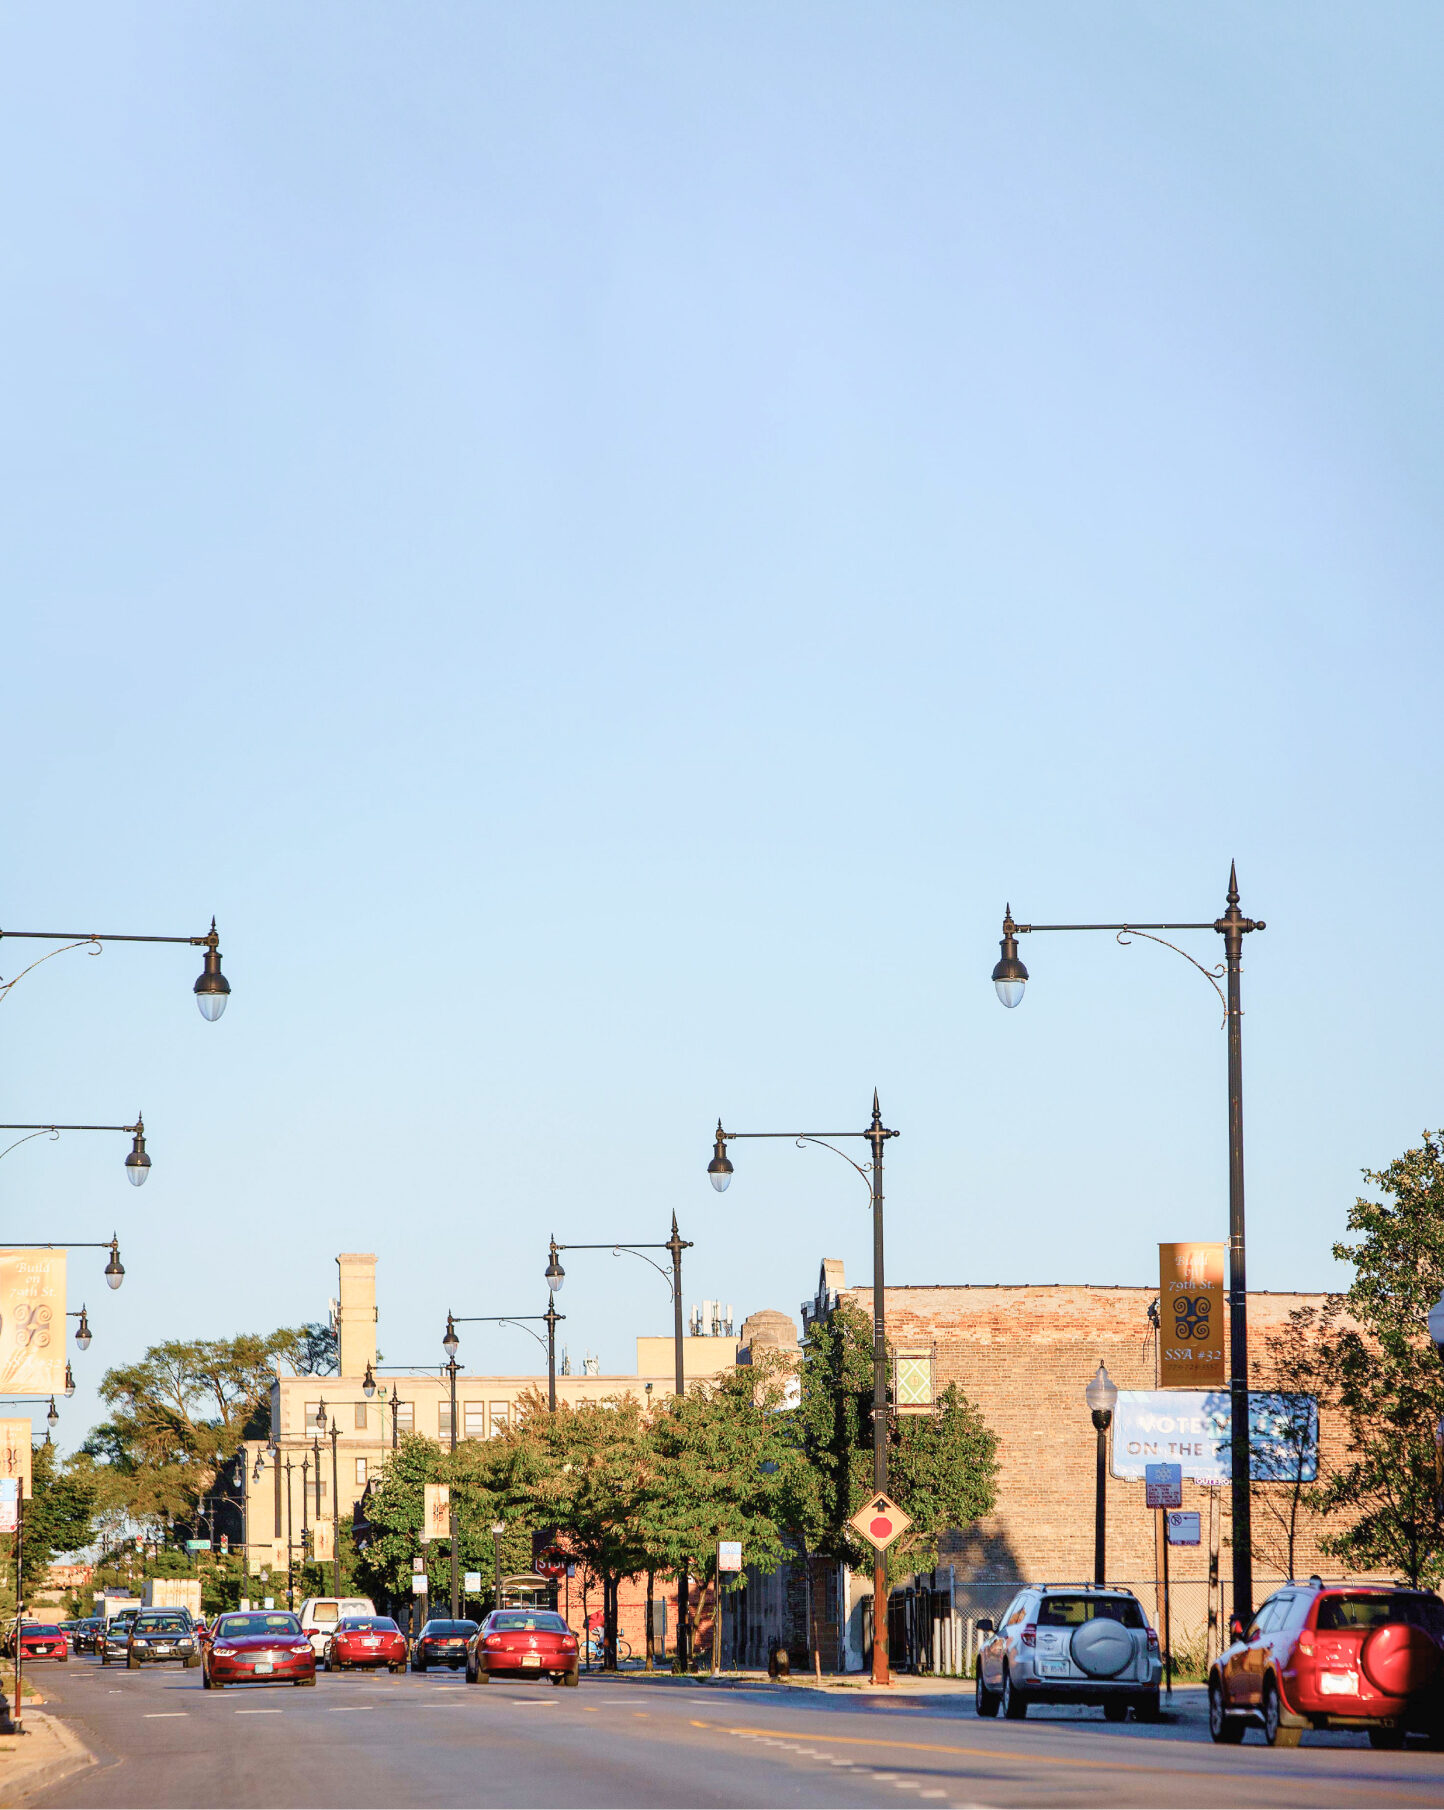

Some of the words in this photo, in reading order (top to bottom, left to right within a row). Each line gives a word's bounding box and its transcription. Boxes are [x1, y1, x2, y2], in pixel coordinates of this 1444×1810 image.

[16, 1261, 50, 1273] Build
[1169, 1277, 1196, 1292] 79th
[1200, 1278, 1215, 1290] St.
[1165, 1348, 1193, 1361] SSA
[1197, 1350, 1222, 1362] #32
[1138, 1416, 1201, 1434] VOTE
[1127, 1441, 1158, 1456] ON
[1168, 1442, 1203, 1457] THE
